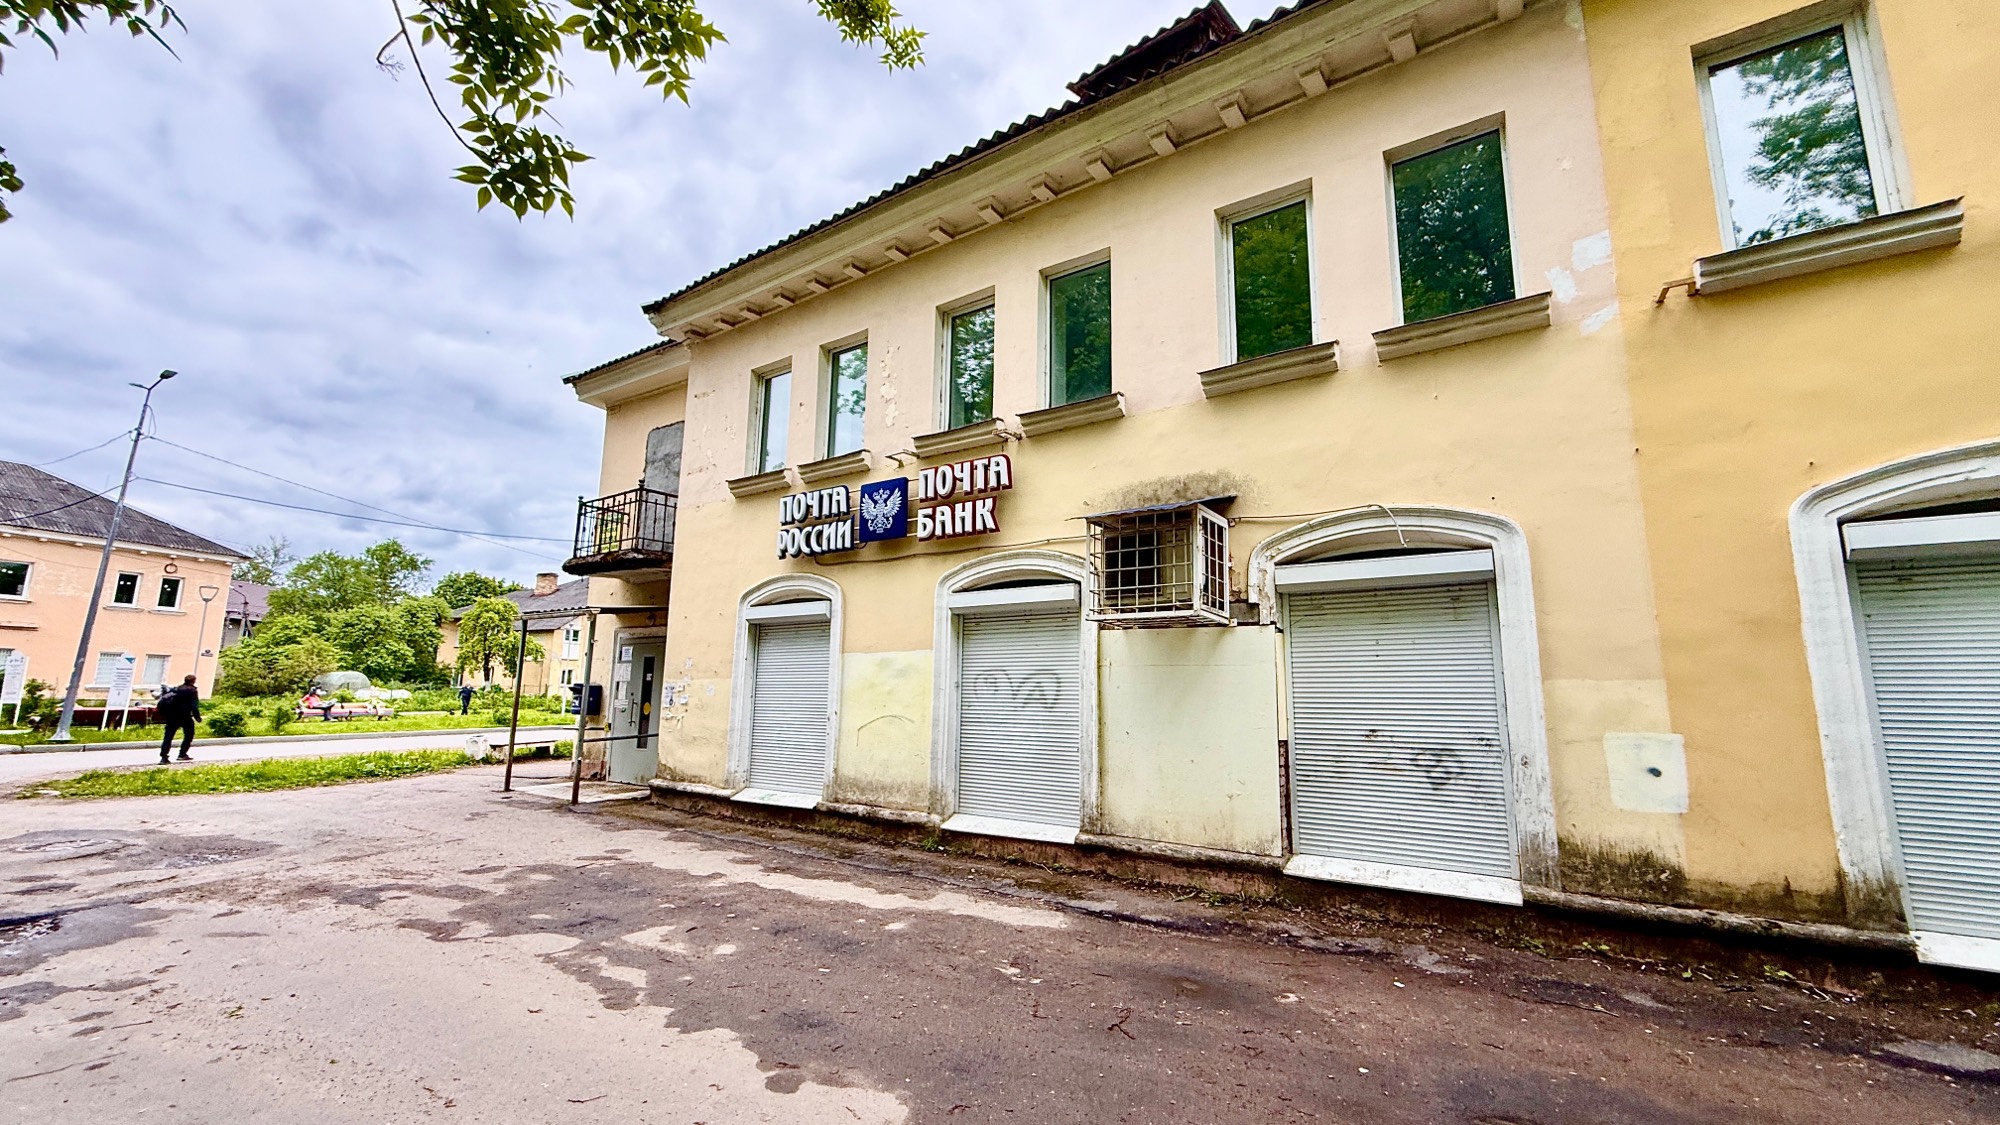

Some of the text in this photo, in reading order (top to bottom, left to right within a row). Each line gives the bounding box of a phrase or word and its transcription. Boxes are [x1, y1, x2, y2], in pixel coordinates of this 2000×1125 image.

[918, 455, 1011, 502] ПОЧТА
[779, 485, 849, 525] ПОЧТА
[917, 497, 999, 540] БАНК
[777, 518, 853, 559] РОССИИ
